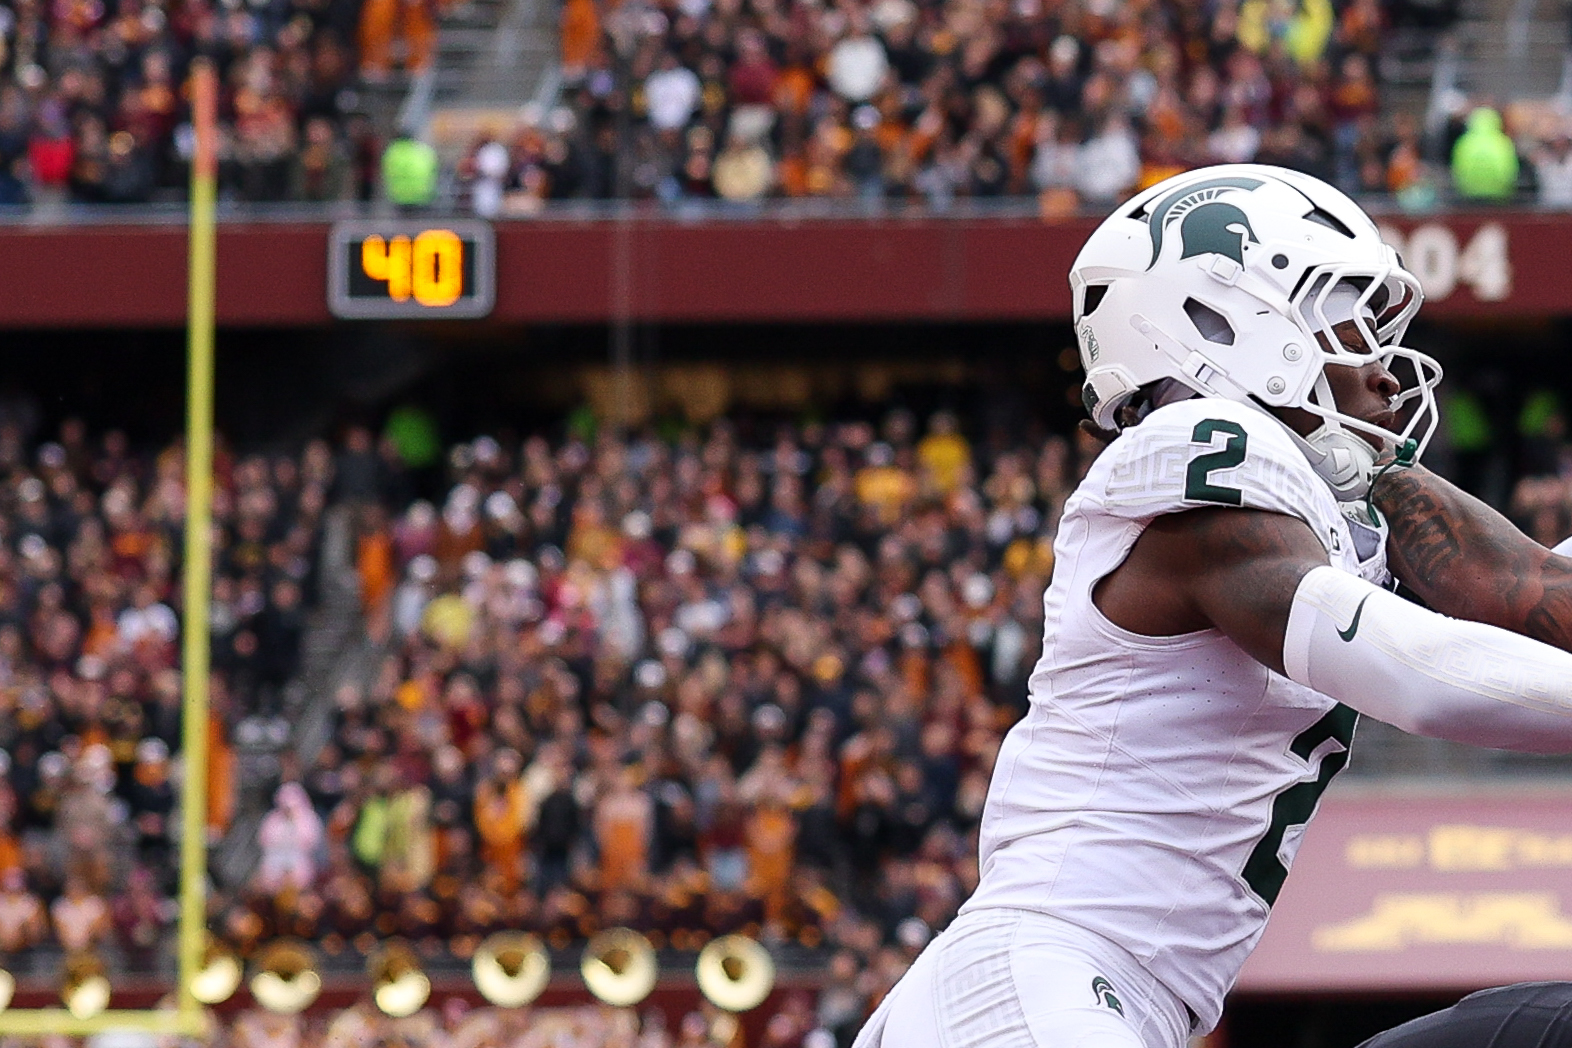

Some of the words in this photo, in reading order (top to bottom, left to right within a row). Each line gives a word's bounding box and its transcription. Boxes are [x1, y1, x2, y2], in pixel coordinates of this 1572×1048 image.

[362, 230, 463, 307] 40
[1184, 418, 1248, 505] 2
[1236, 701, 1359, 913] 2
